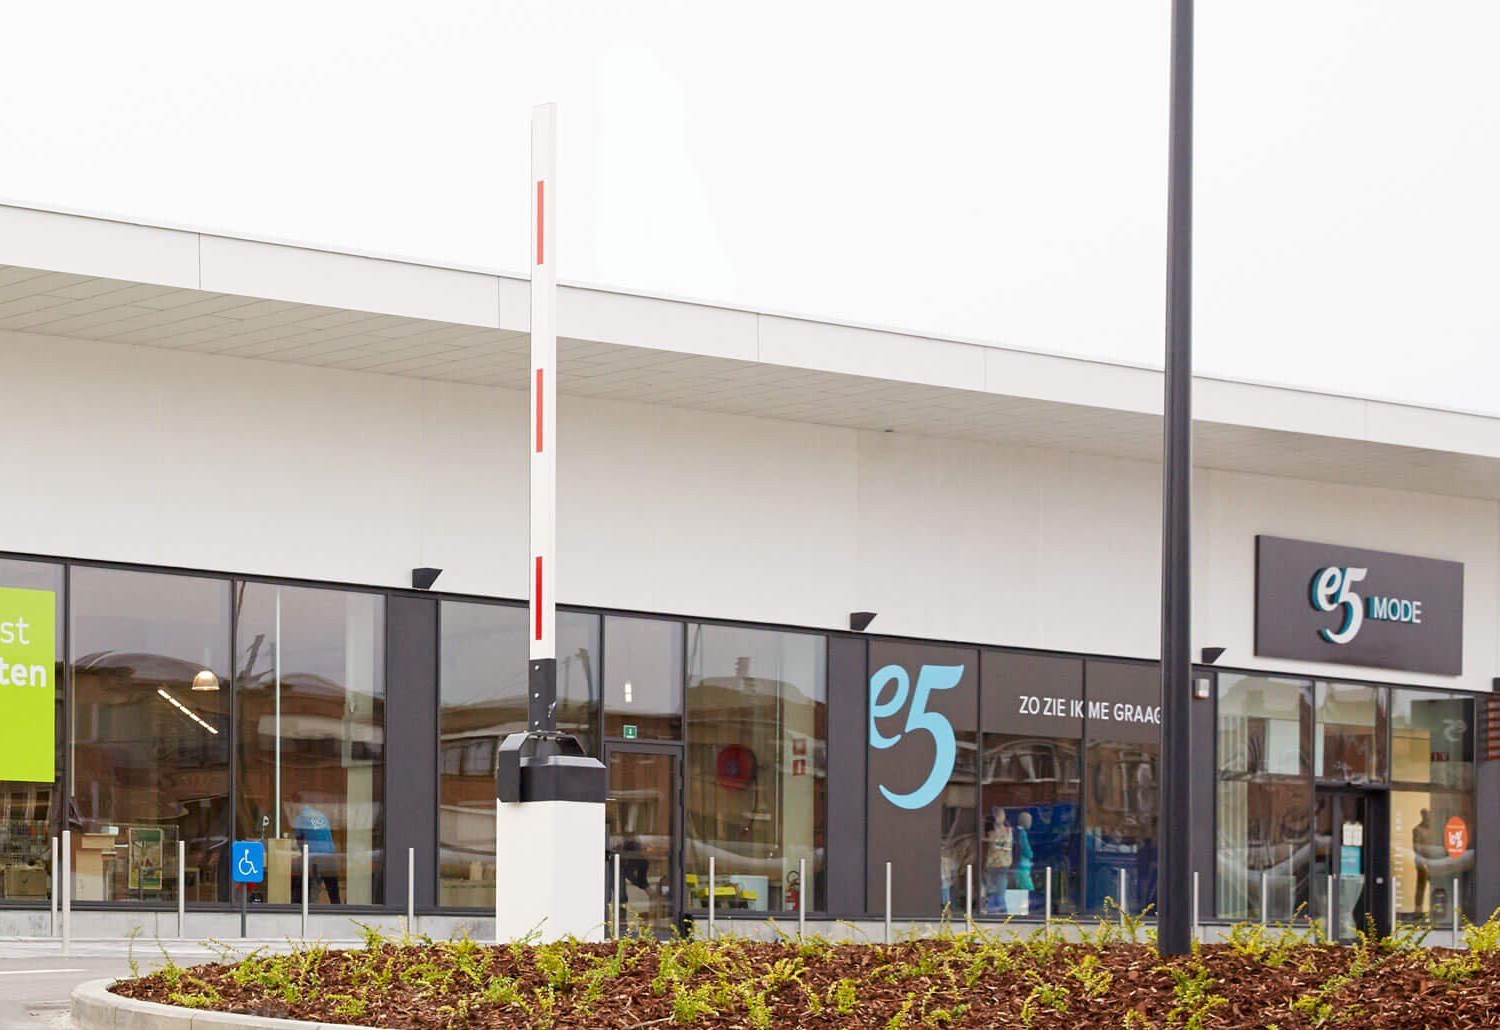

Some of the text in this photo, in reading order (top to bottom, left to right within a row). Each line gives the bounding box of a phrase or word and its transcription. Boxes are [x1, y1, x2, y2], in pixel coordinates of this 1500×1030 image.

[1315, 566, 1422, 644] e5 MODE
[869, 664, 965, 810] e5
[1019, 696, 1040, 715] ZO
[1043, 698, 1066, 717] ZIE
[1070, 700, 1084, 718] IK
[1088, 701, 1109, 720] ME
